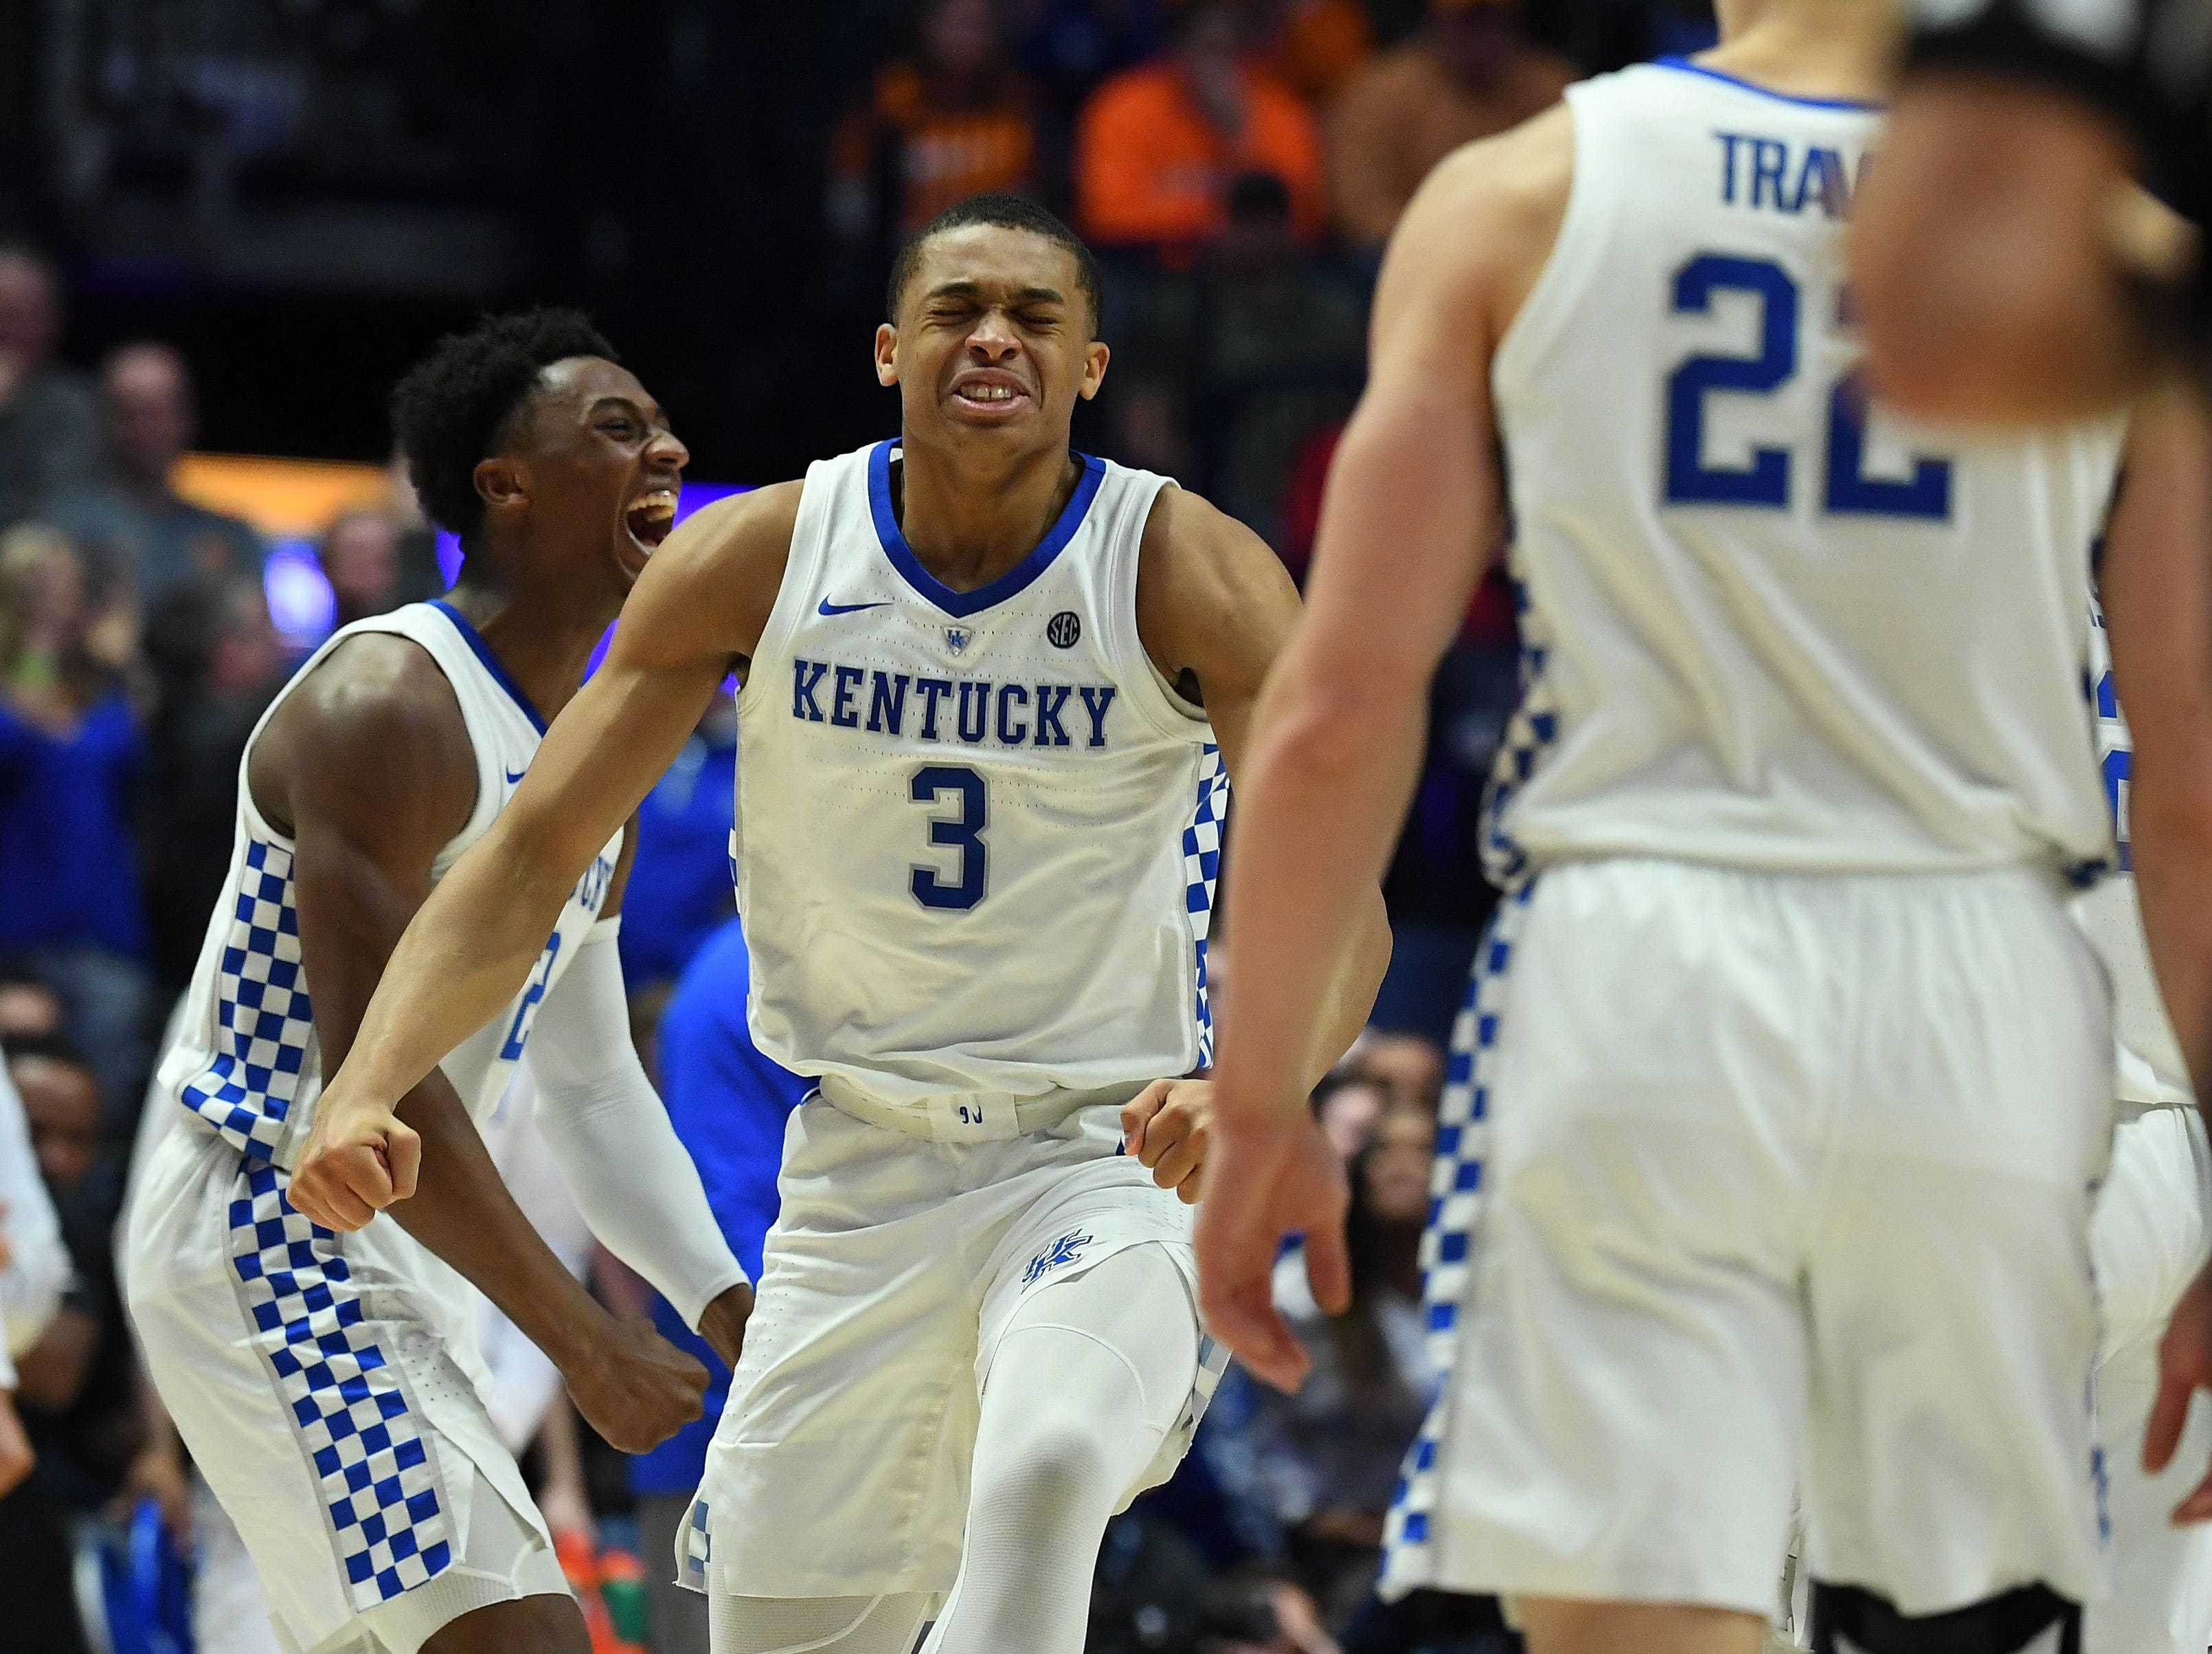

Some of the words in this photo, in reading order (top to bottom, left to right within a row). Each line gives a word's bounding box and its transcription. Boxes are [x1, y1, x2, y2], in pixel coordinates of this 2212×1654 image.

[1050, 614, 1078, 645] SEC
[793, 658, 1118, 749] KENTUCKY
[907, 762, 991, 911] 3
